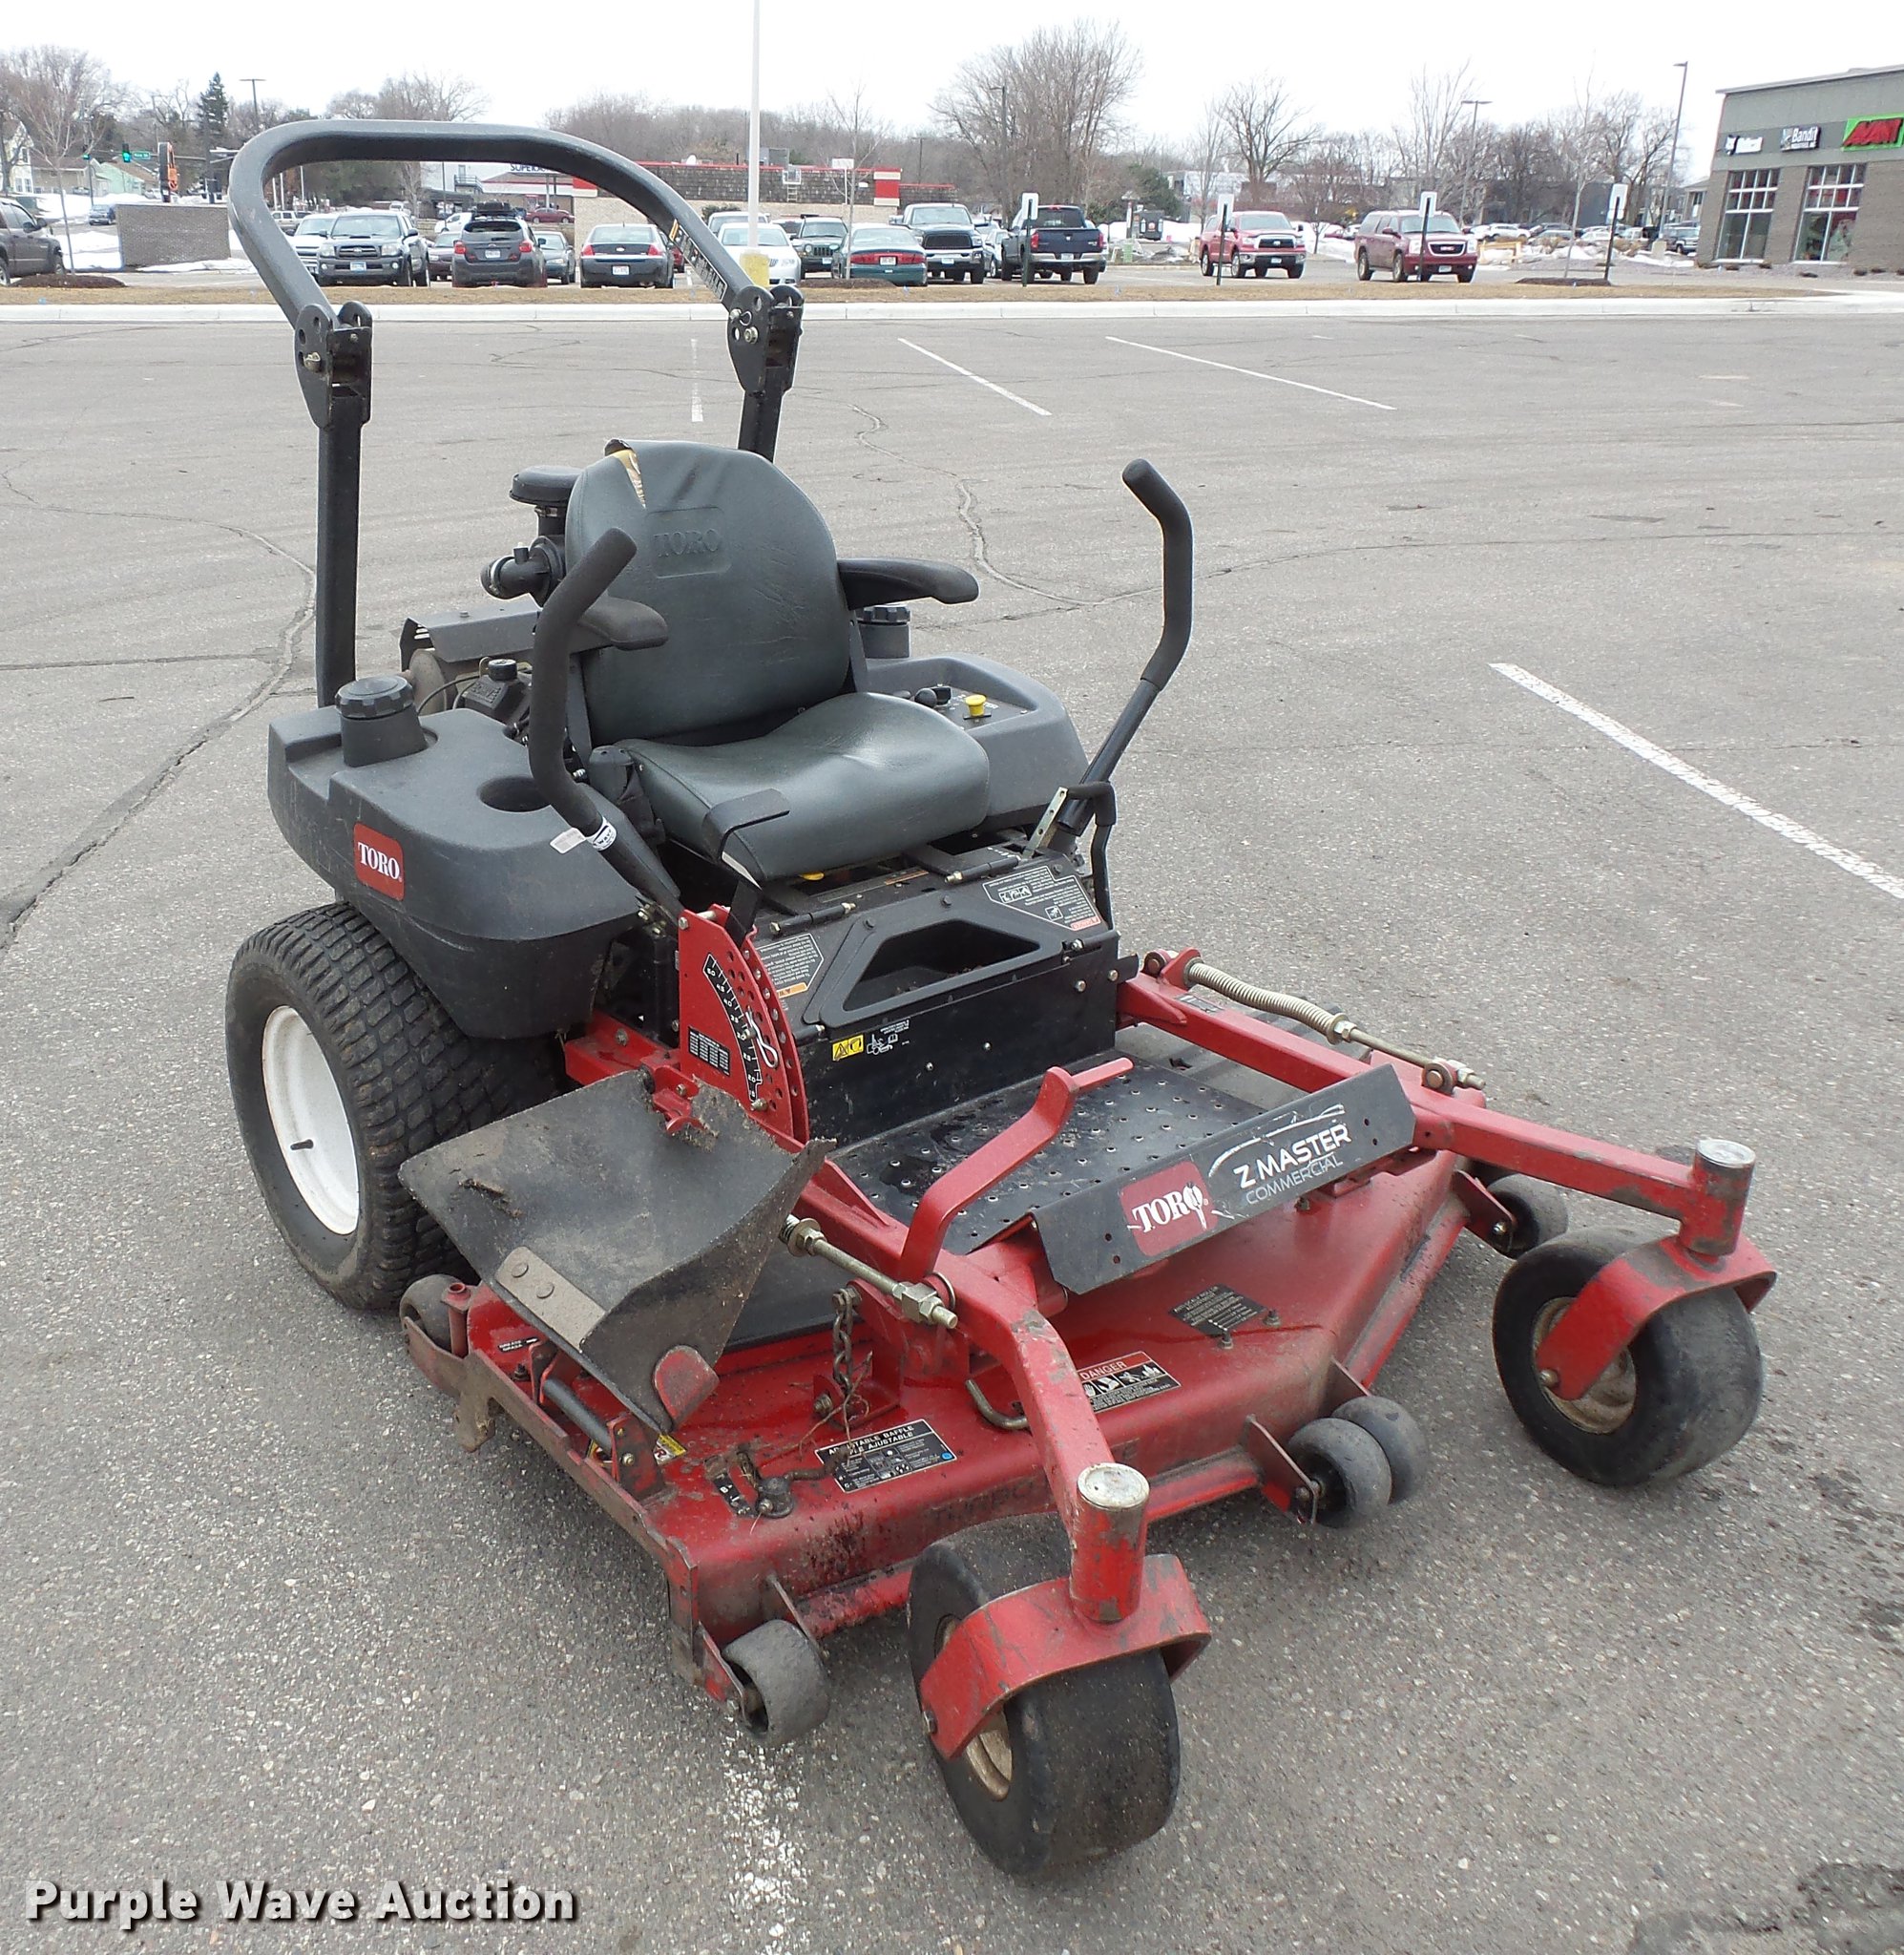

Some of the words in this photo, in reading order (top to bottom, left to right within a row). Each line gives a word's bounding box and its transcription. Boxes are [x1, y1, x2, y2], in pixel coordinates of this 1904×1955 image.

[653, 528, 721, 557] TORO
[357, 841, 401, 880] TORO
[1233, 1165, 1257, 1189] Z
[1257, 1124, 1351, 1182] MASTER
[1245, 1153, 1344, 1205] COMMERCIAL
[1132, 1183, 1204, 1233] TORO
[1078, 1360, 1128, 1380] DANGER
[882, 1425, 914, 1440] BAFFLE
